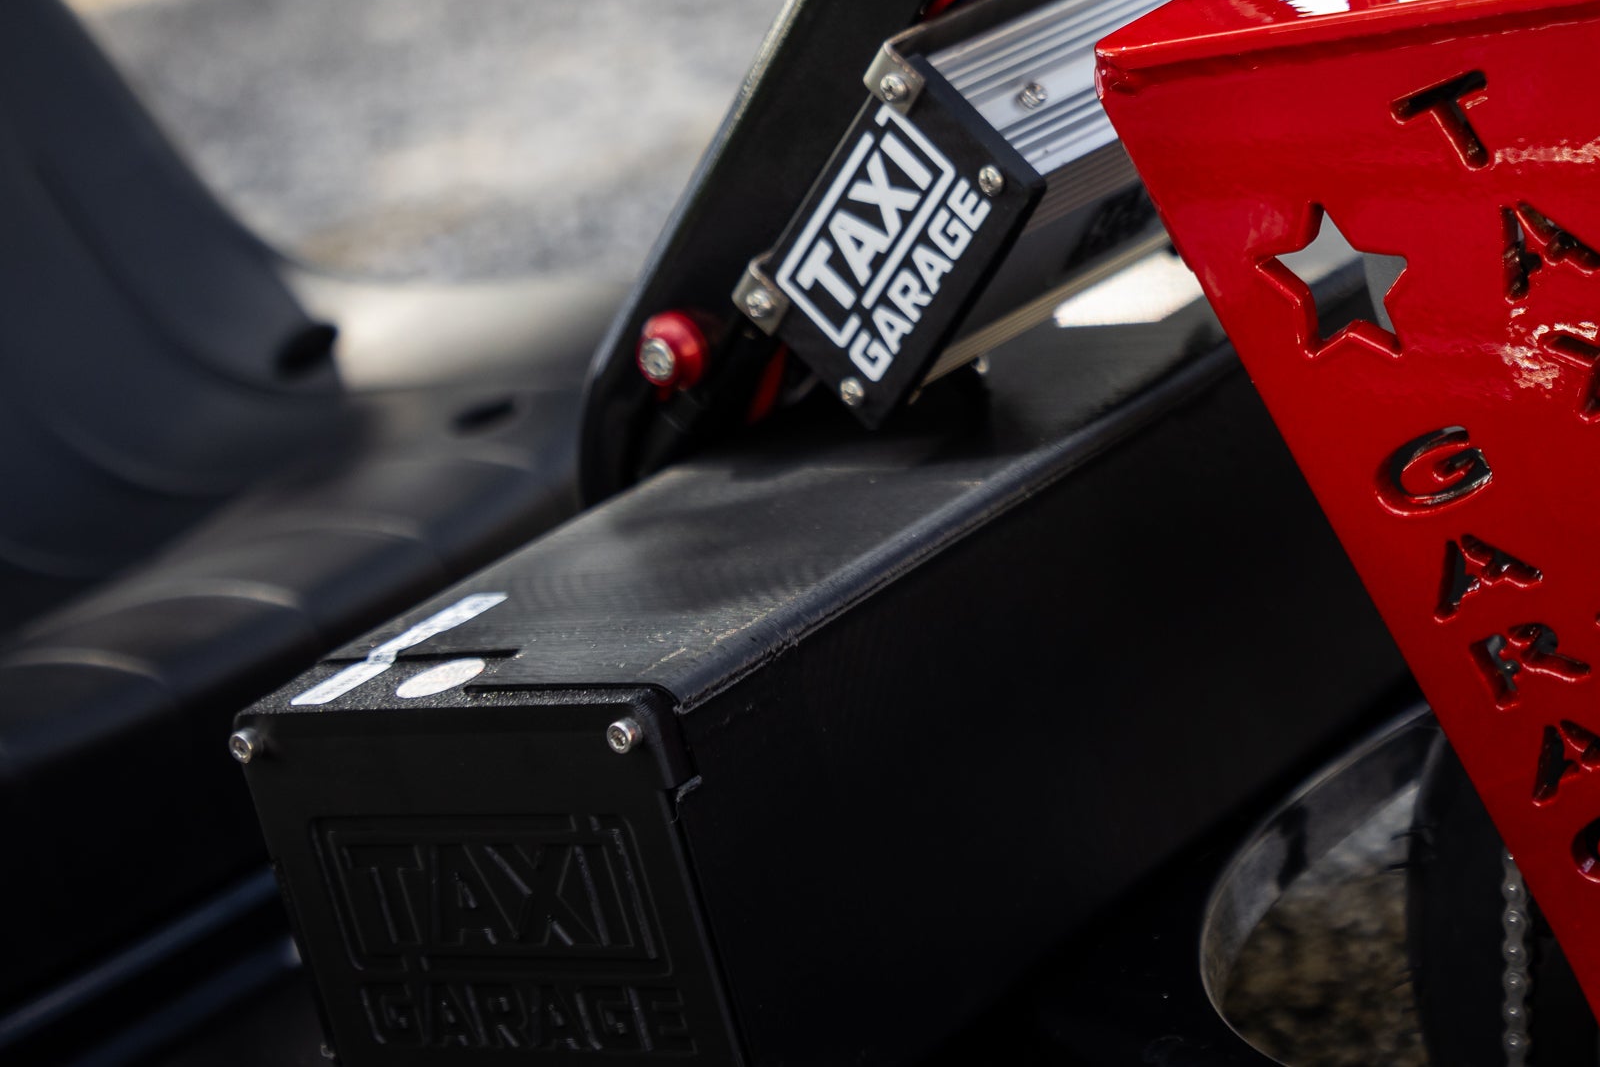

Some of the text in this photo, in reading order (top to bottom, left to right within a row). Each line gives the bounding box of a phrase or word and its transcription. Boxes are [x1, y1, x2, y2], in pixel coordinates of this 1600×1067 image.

[797, 132, 934, 310] TAXI
[848, 177, 992, 382] GARAGE
[341, 843, 635, 948] TAXI
[360, 983, 698, 1055] GARAGE
